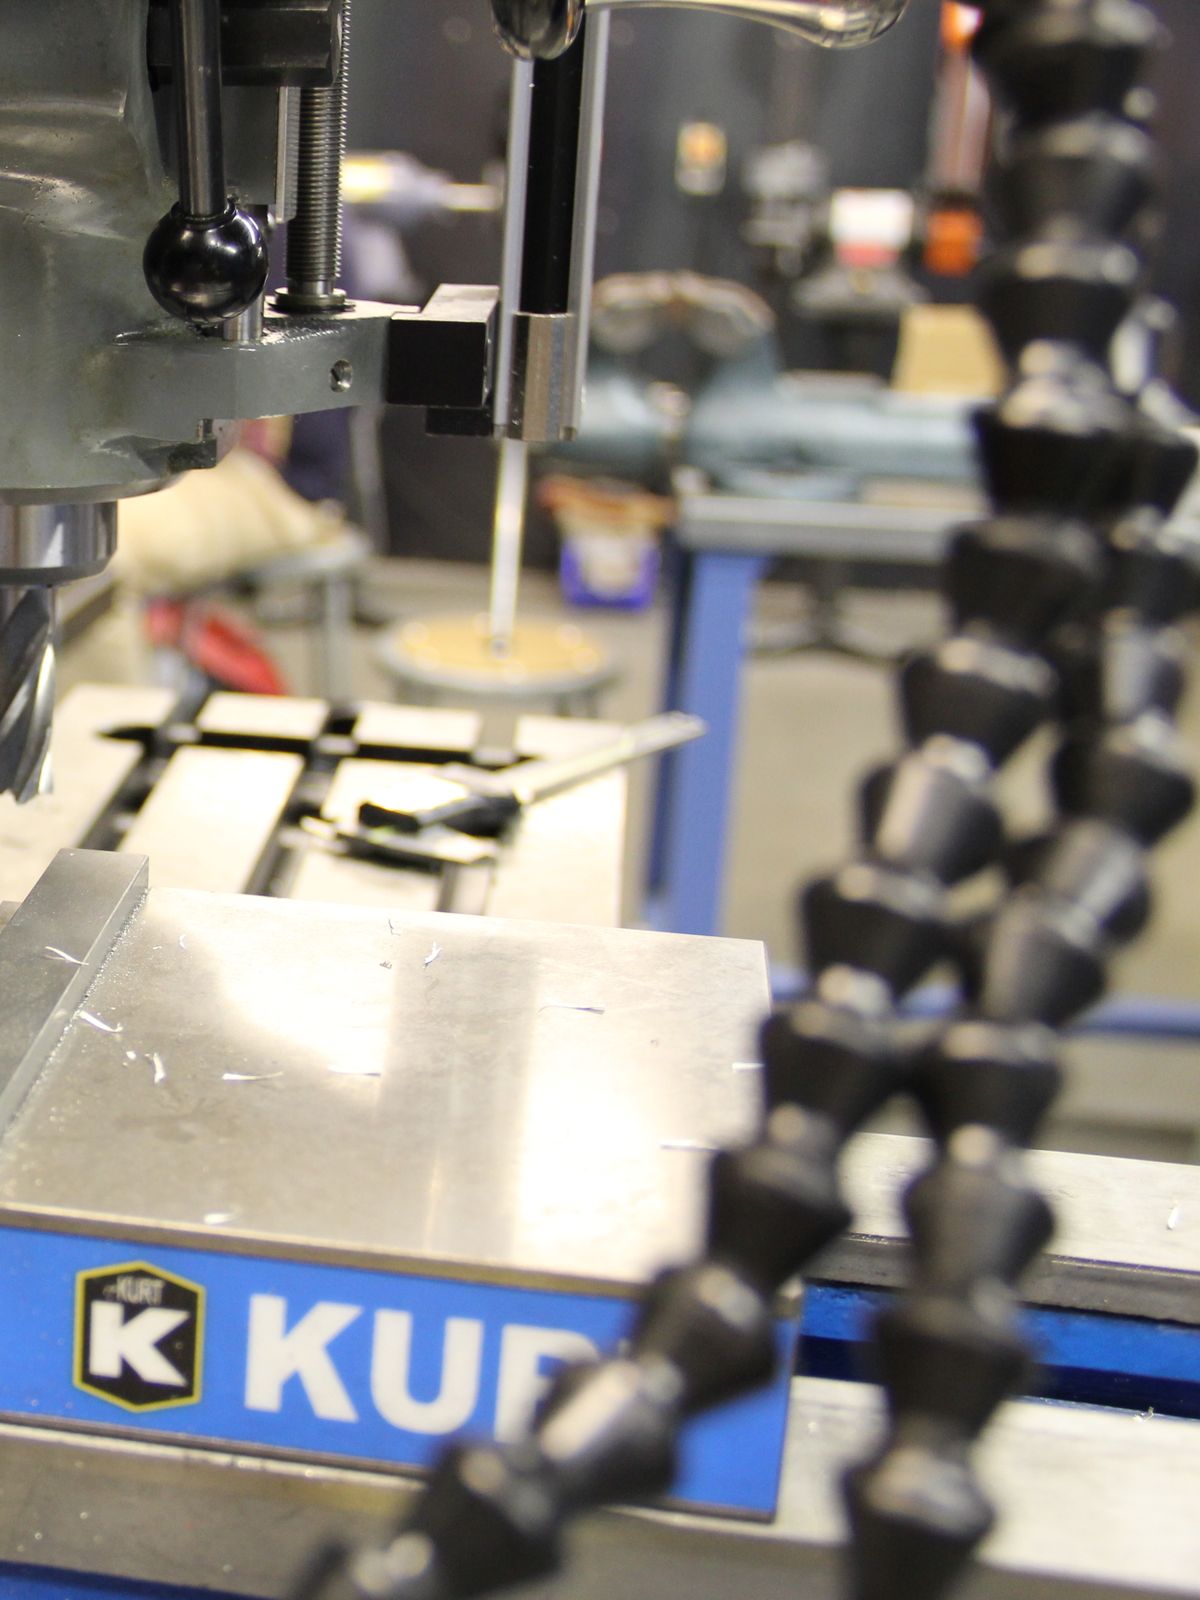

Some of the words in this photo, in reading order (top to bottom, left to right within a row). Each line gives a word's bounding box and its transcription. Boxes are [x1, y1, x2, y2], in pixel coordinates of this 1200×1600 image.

[116, 1275, 165, 1305] KURT
[89, 1300, 190, 1387] K
[244, 1293, 632, 1445] KUR
